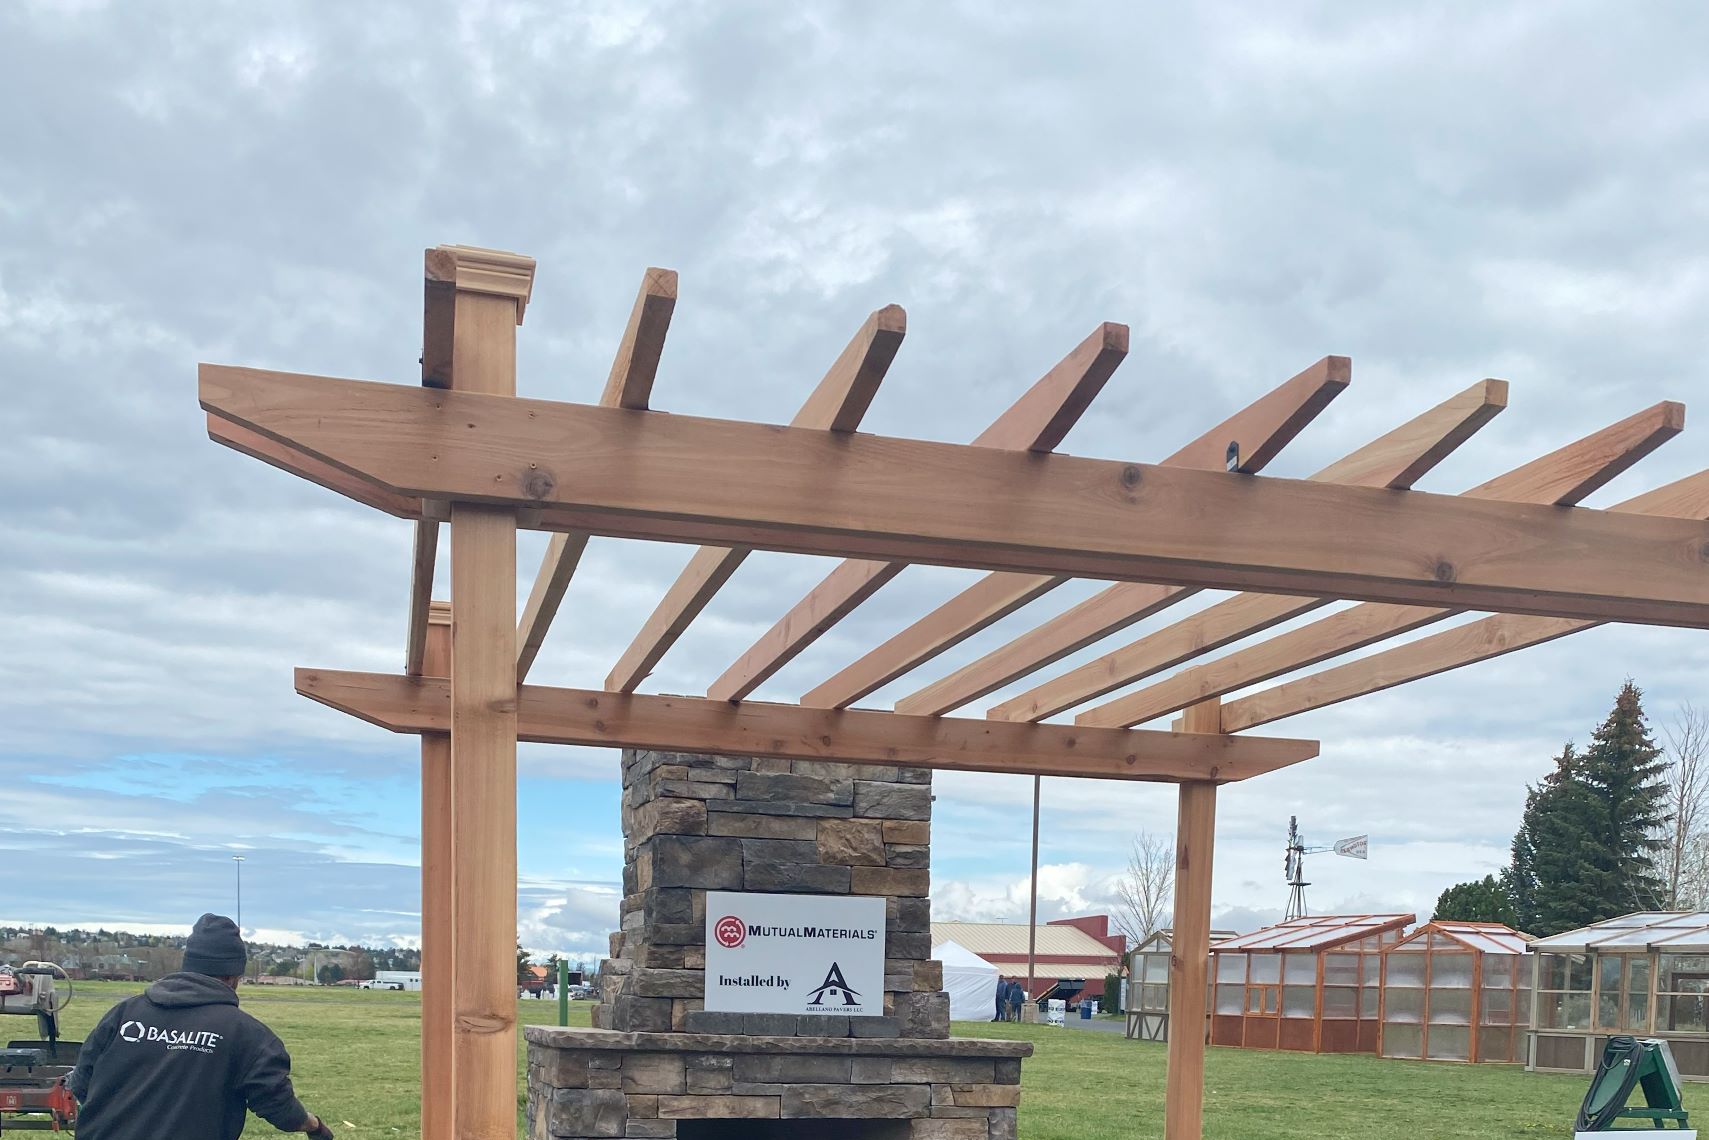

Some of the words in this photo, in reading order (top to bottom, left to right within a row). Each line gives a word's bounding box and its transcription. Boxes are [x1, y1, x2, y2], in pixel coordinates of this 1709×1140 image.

[719, 975, 774, 987] Installed
[777, 976, 791, 990] by
[147, 1026, 220, 1048] BASALITE
